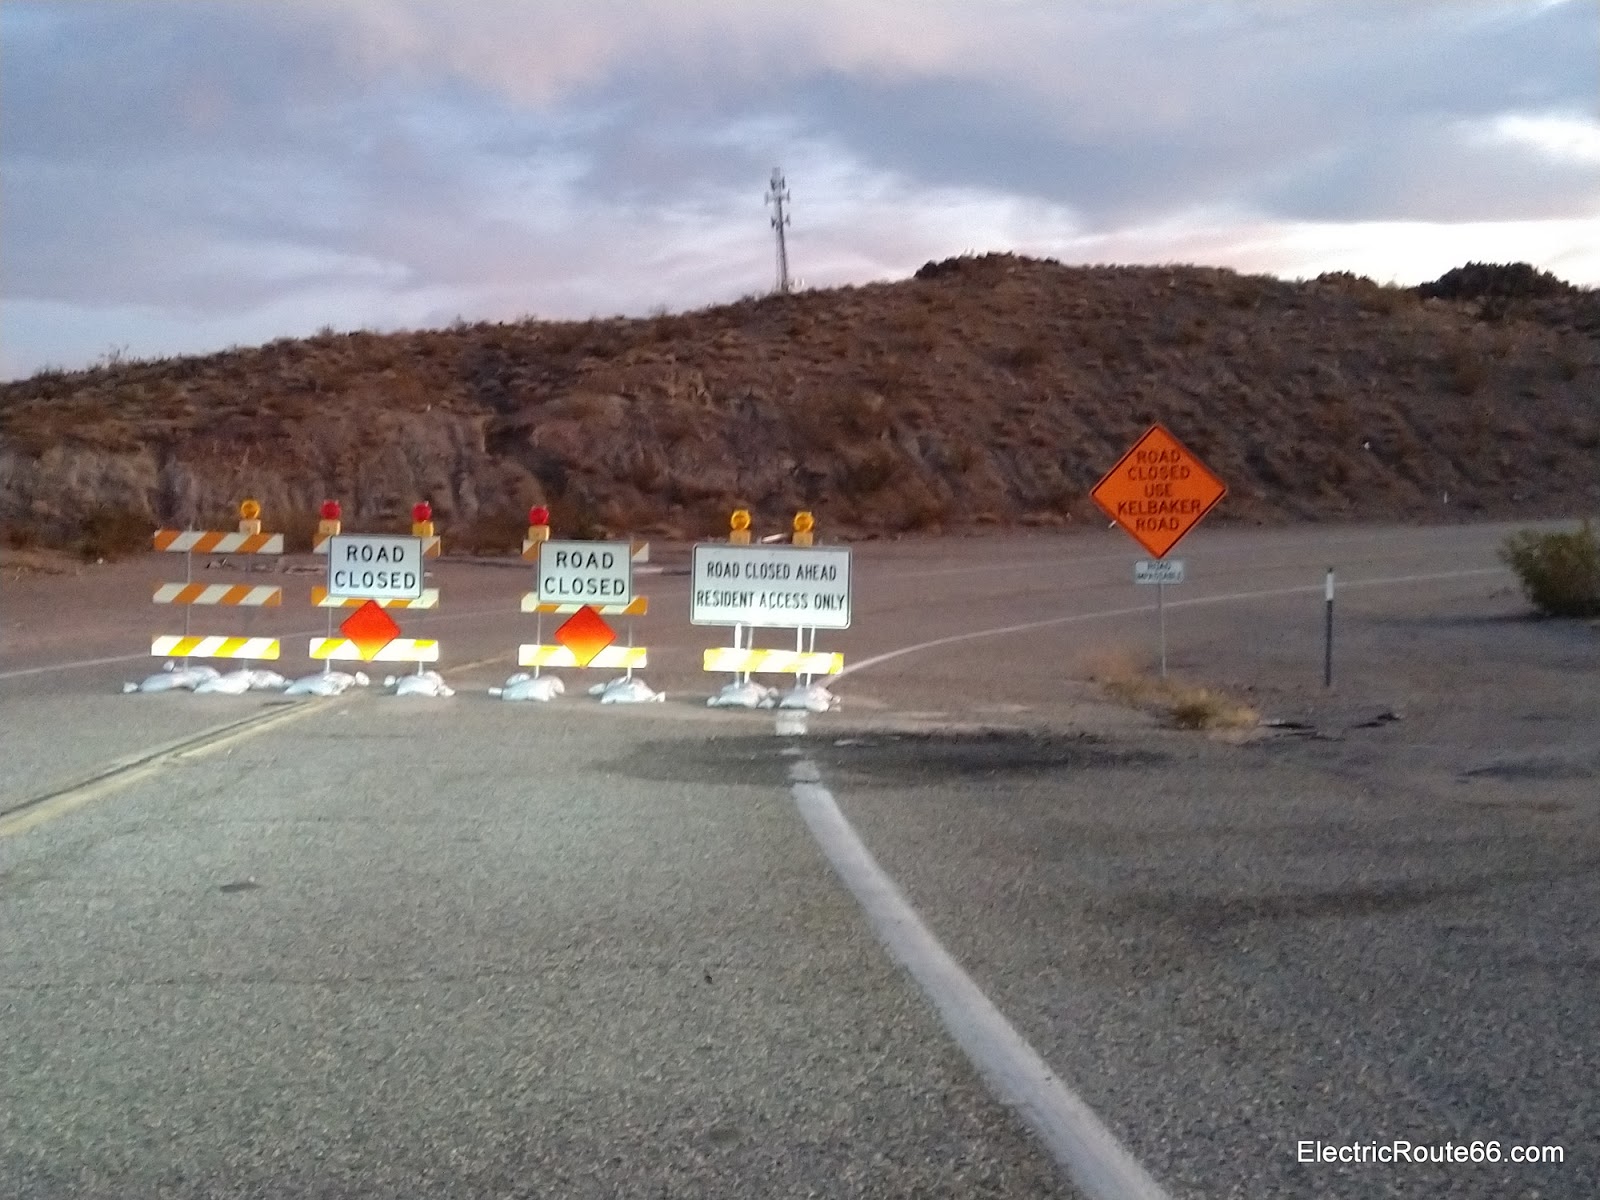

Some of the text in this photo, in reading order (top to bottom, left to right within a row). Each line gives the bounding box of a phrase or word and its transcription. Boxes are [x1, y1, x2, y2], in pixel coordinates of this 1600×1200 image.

[1137, 449, 1180, 463] ROAD
[1127, 465, 1191, 480] CLOSED
[1117, 499, 1201, 516] KELBAKER
[1135, 517, 1179, 531] ROAD
[346, 544, 404, 562] ROAD
[556, 550, 614, 569] ROAD
[334, 570, 416, 589] CLOSED
[706, 561, 837, 581] ROAD CLOSED AHEAD
[544, 576, 625, 595] CLOSED
[696, 590, 845, 611] RESIDENT ACCESS ONLY
